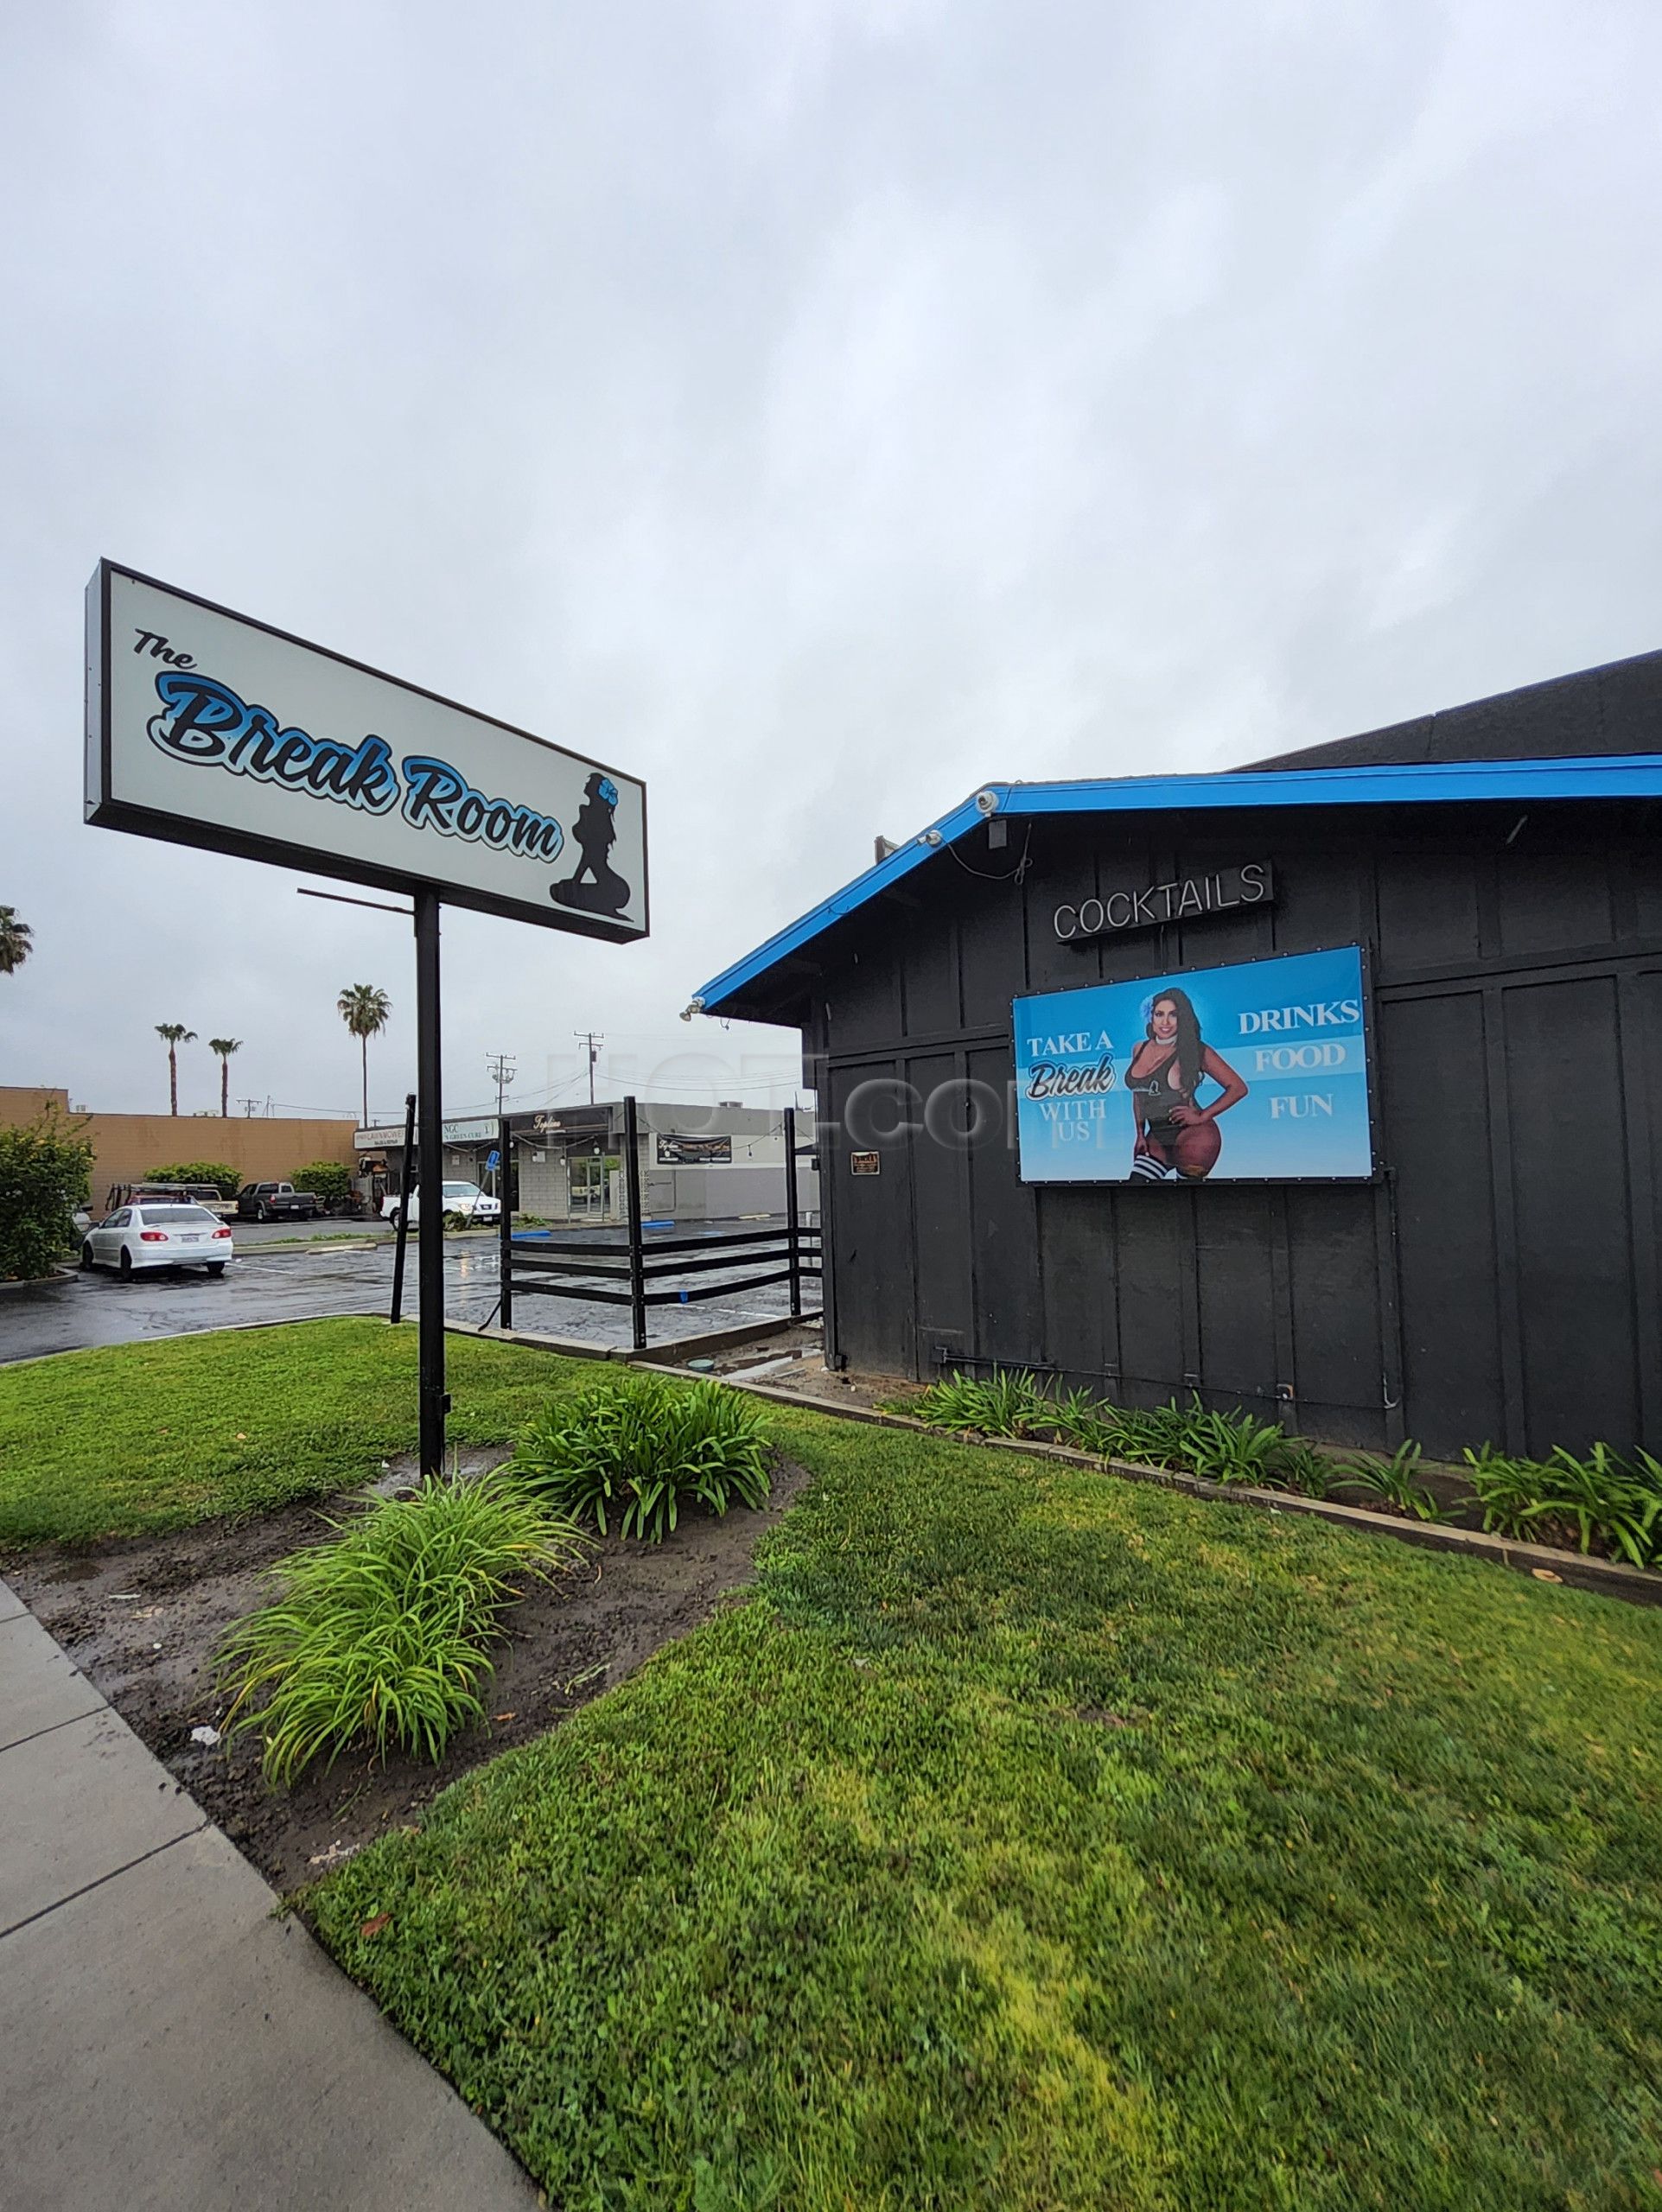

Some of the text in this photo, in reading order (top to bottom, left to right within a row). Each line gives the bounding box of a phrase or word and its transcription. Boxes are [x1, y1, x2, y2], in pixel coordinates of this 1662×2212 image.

[134, 627, 197, 670] The
[146, 671, 565, 864] Break Room
[1053, 864, 1265, 939] COCKTAILS
[1238, 999, 1361, 1035] DRINKS
[1027, 1030, 1115, 1058] TAKE A
[1255, 1042, 1347, 1072] FOOD
[1024, 1052, 1117, 1101] Break
[1039, 1098, 1107, 1122] WITH
[1269, 1093, 1334, 1120] FUN
[1057, 1122, 1091, 1141] US
